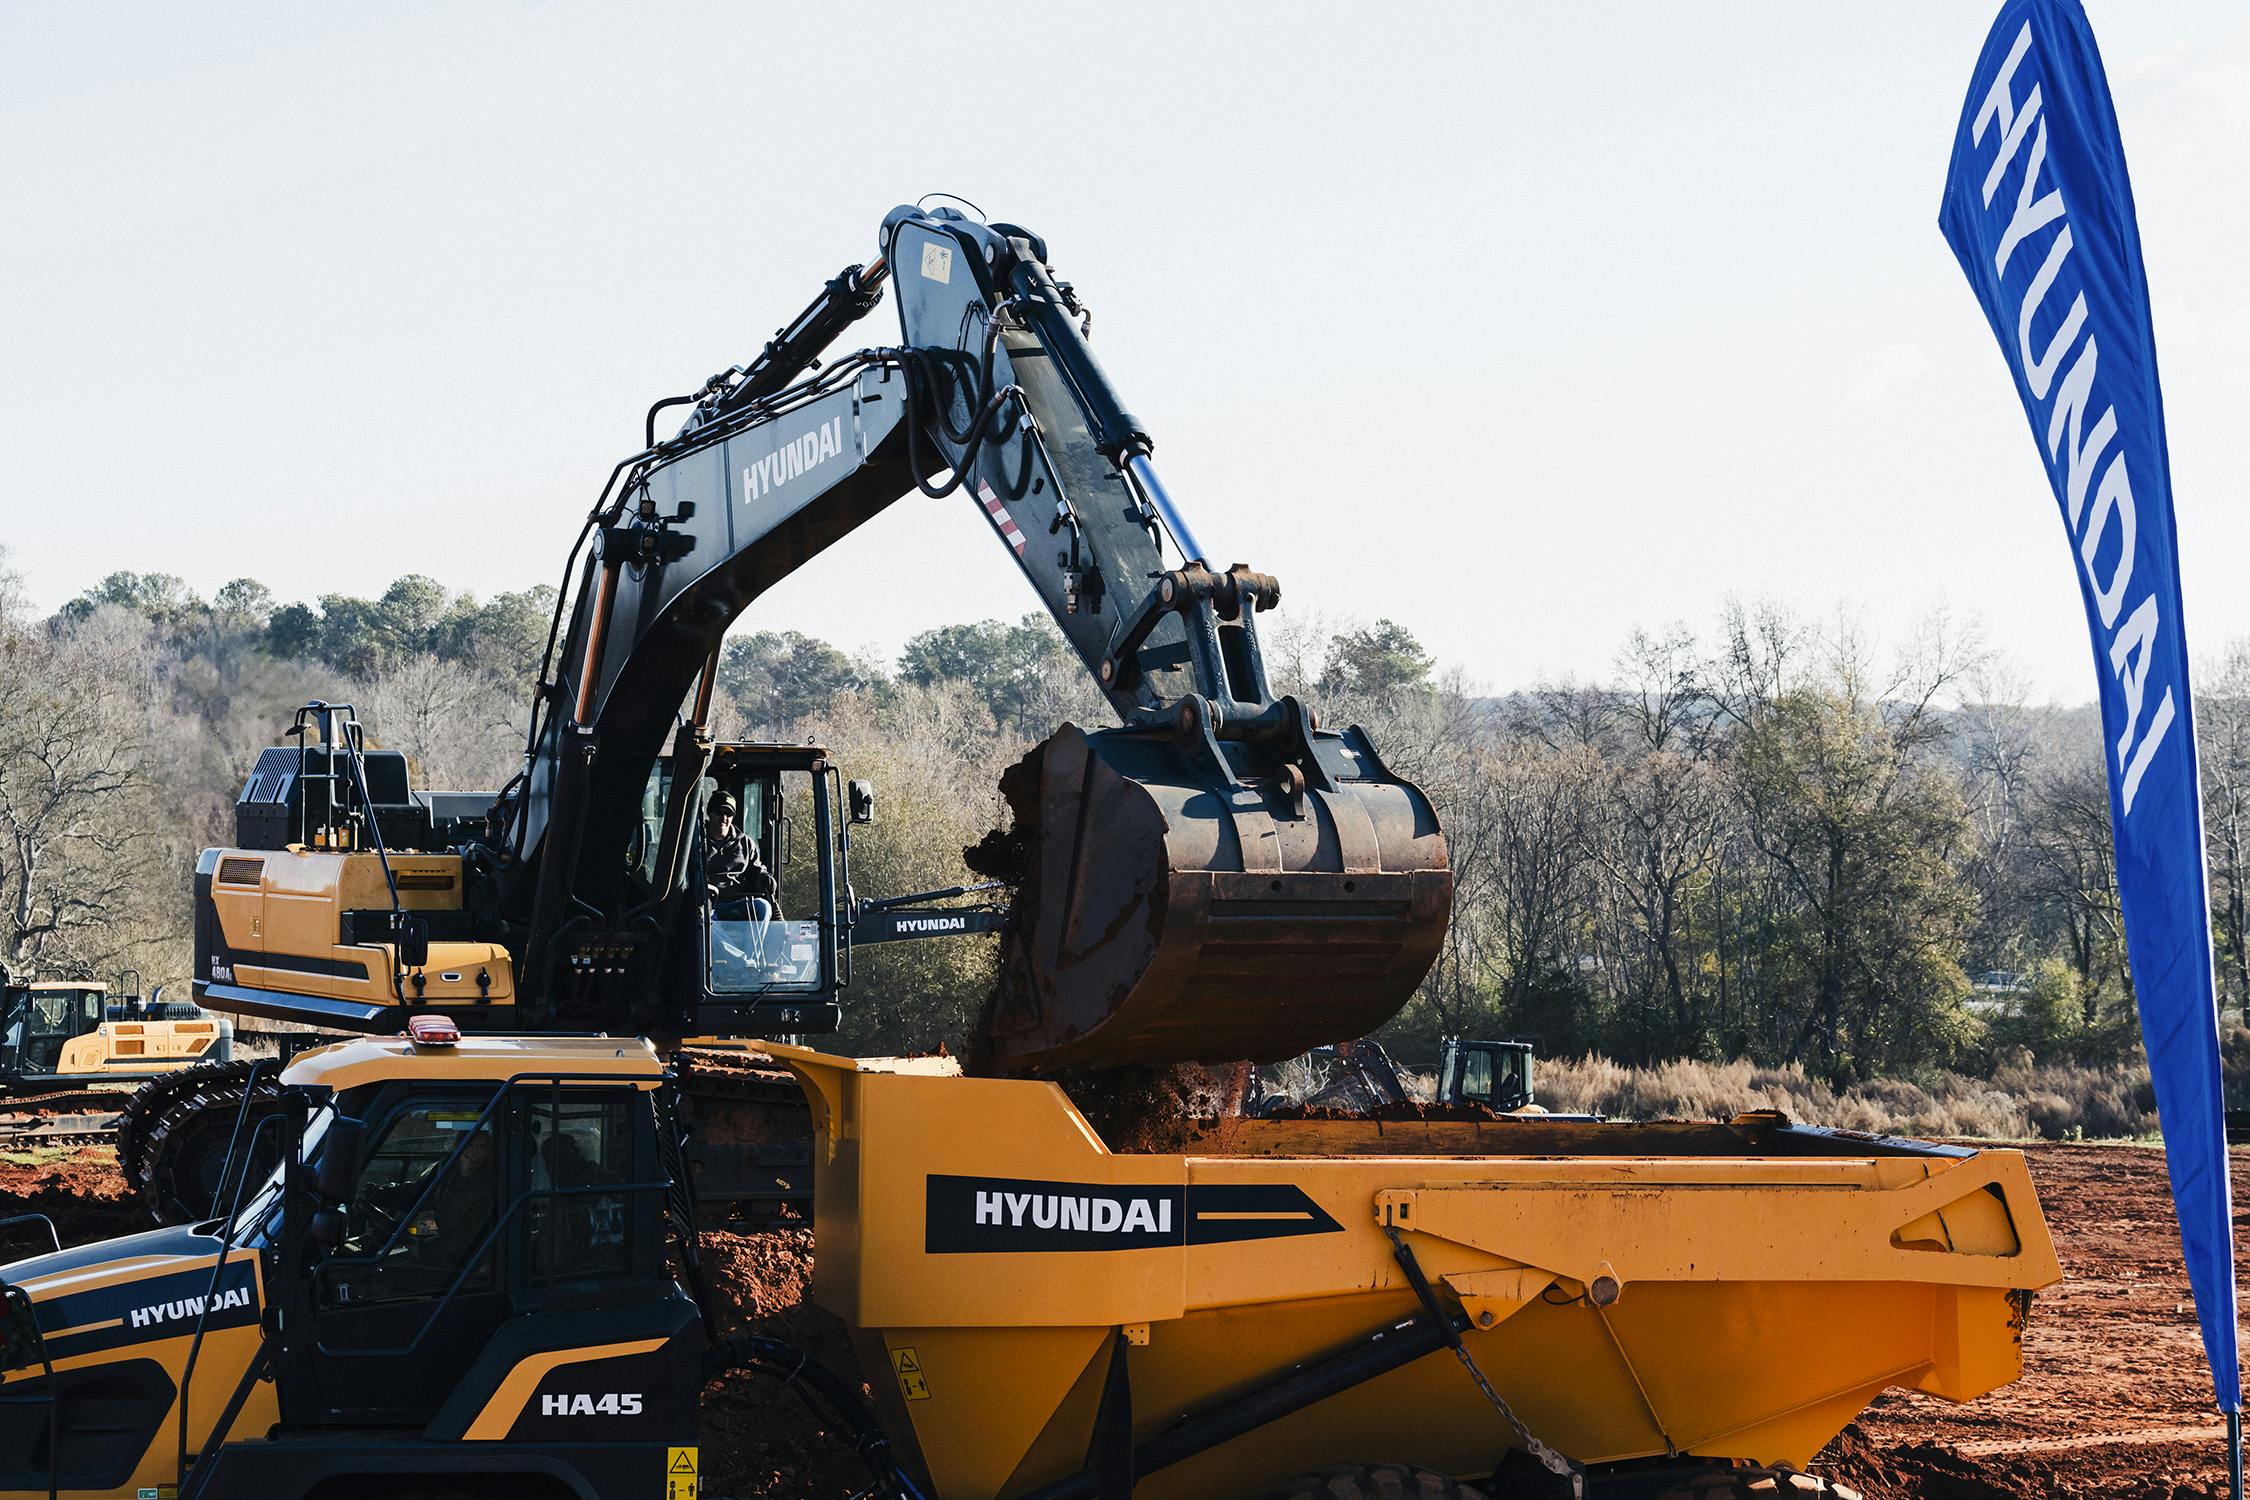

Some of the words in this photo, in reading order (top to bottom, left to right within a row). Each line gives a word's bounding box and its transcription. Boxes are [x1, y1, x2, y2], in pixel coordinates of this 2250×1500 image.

[1972, 18, 2175, 817] HYUNDAI
[743, 415, 842, 505] HYUNDAI
[896, 917, 965, 932] HYUNDAI
[975, 1191, 1172, 1233] HYUNDAI
[542, 1393, 643, 1416] HA45
